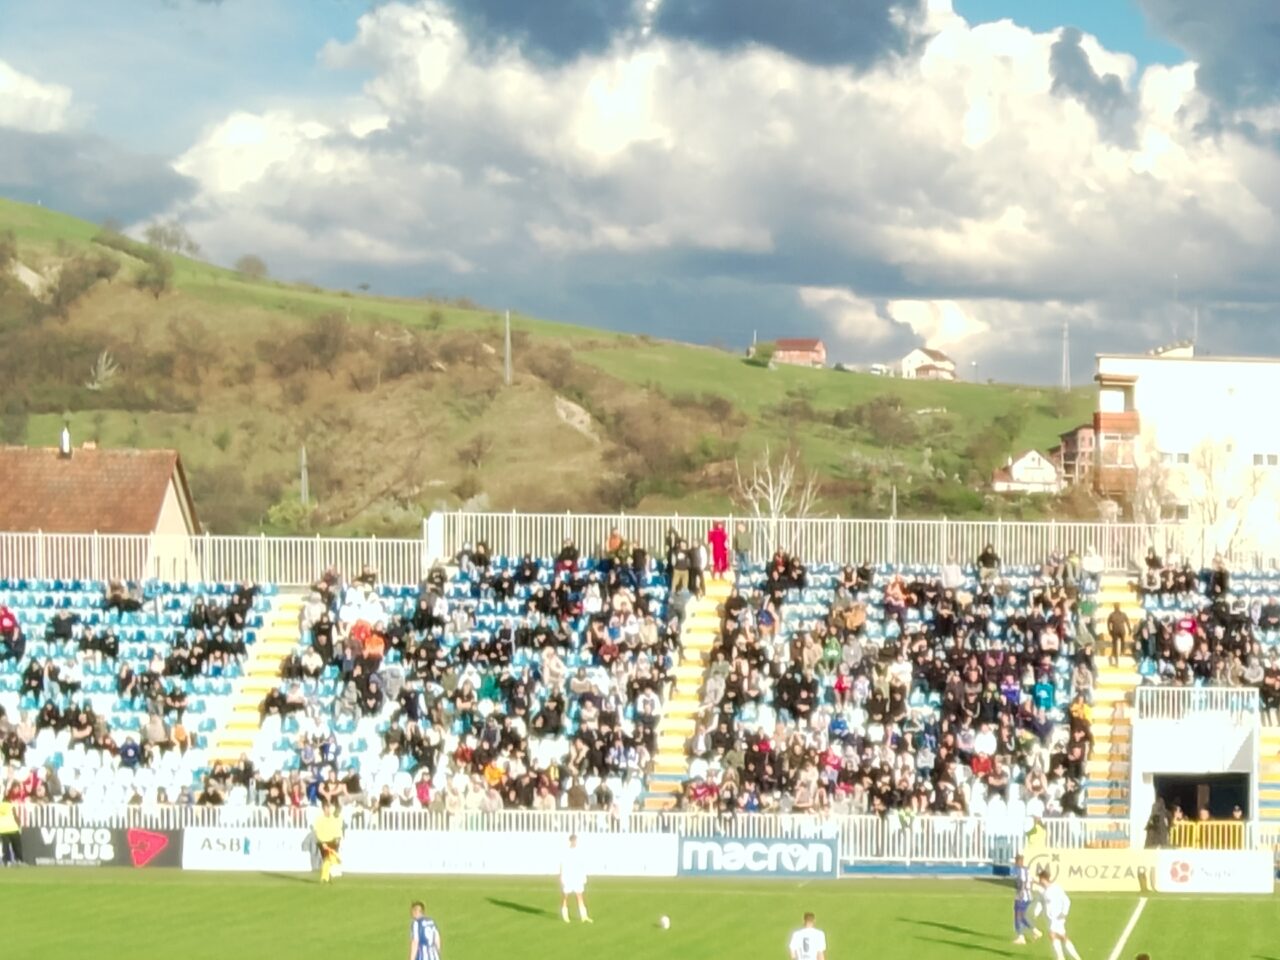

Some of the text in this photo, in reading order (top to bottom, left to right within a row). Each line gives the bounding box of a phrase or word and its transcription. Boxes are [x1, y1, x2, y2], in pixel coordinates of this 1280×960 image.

[41, 827, 111, 845] VIDEO
[200, 837, 241, 852] ASB
[55, 843, 114, 861] PLUS
[683, 841, 832, 872] macron
[1068, 865, 1156, 879] MOZZAR
